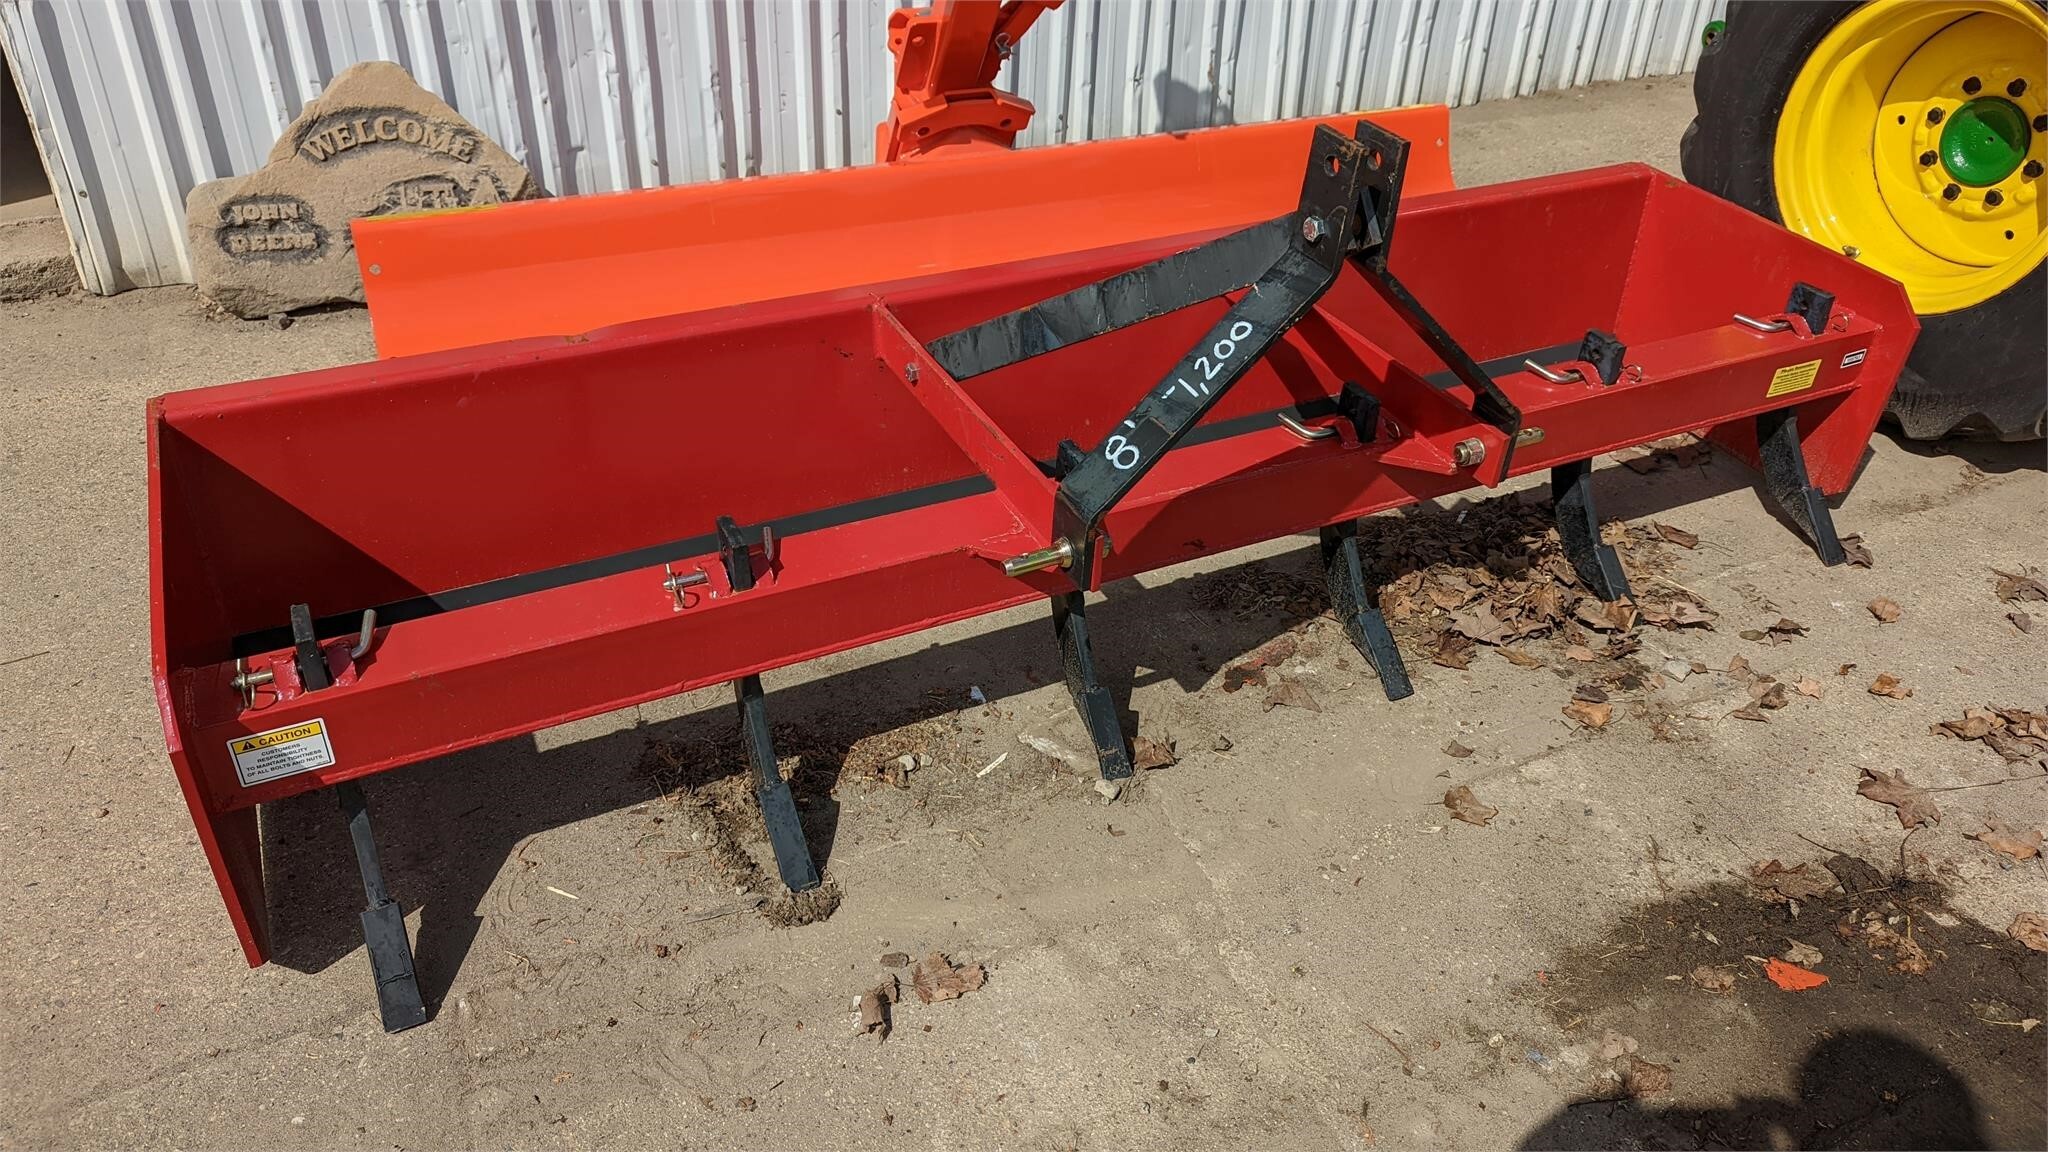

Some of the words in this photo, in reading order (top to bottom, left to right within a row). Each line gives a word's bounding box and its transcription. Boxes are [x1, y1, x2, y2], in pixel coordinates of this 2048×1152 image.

[301, 116, 475, 163] WELCOME
[230, 203, 300, 225] JOHN
[229, 232, 317, 253] DEERE
[259, 727, 311, 746] CAUTION
[256, 758, 287, 769] MAINTAIN
[287, 749, 322, 761] TIGHTNESS
[257, 747, 308, 763] RESPONSIBILITY
[261, 743, 301, 756] CUSTOMERS
[257, 768, 270, 776] ALL
[270, 763, 291, 771] BOLTS
